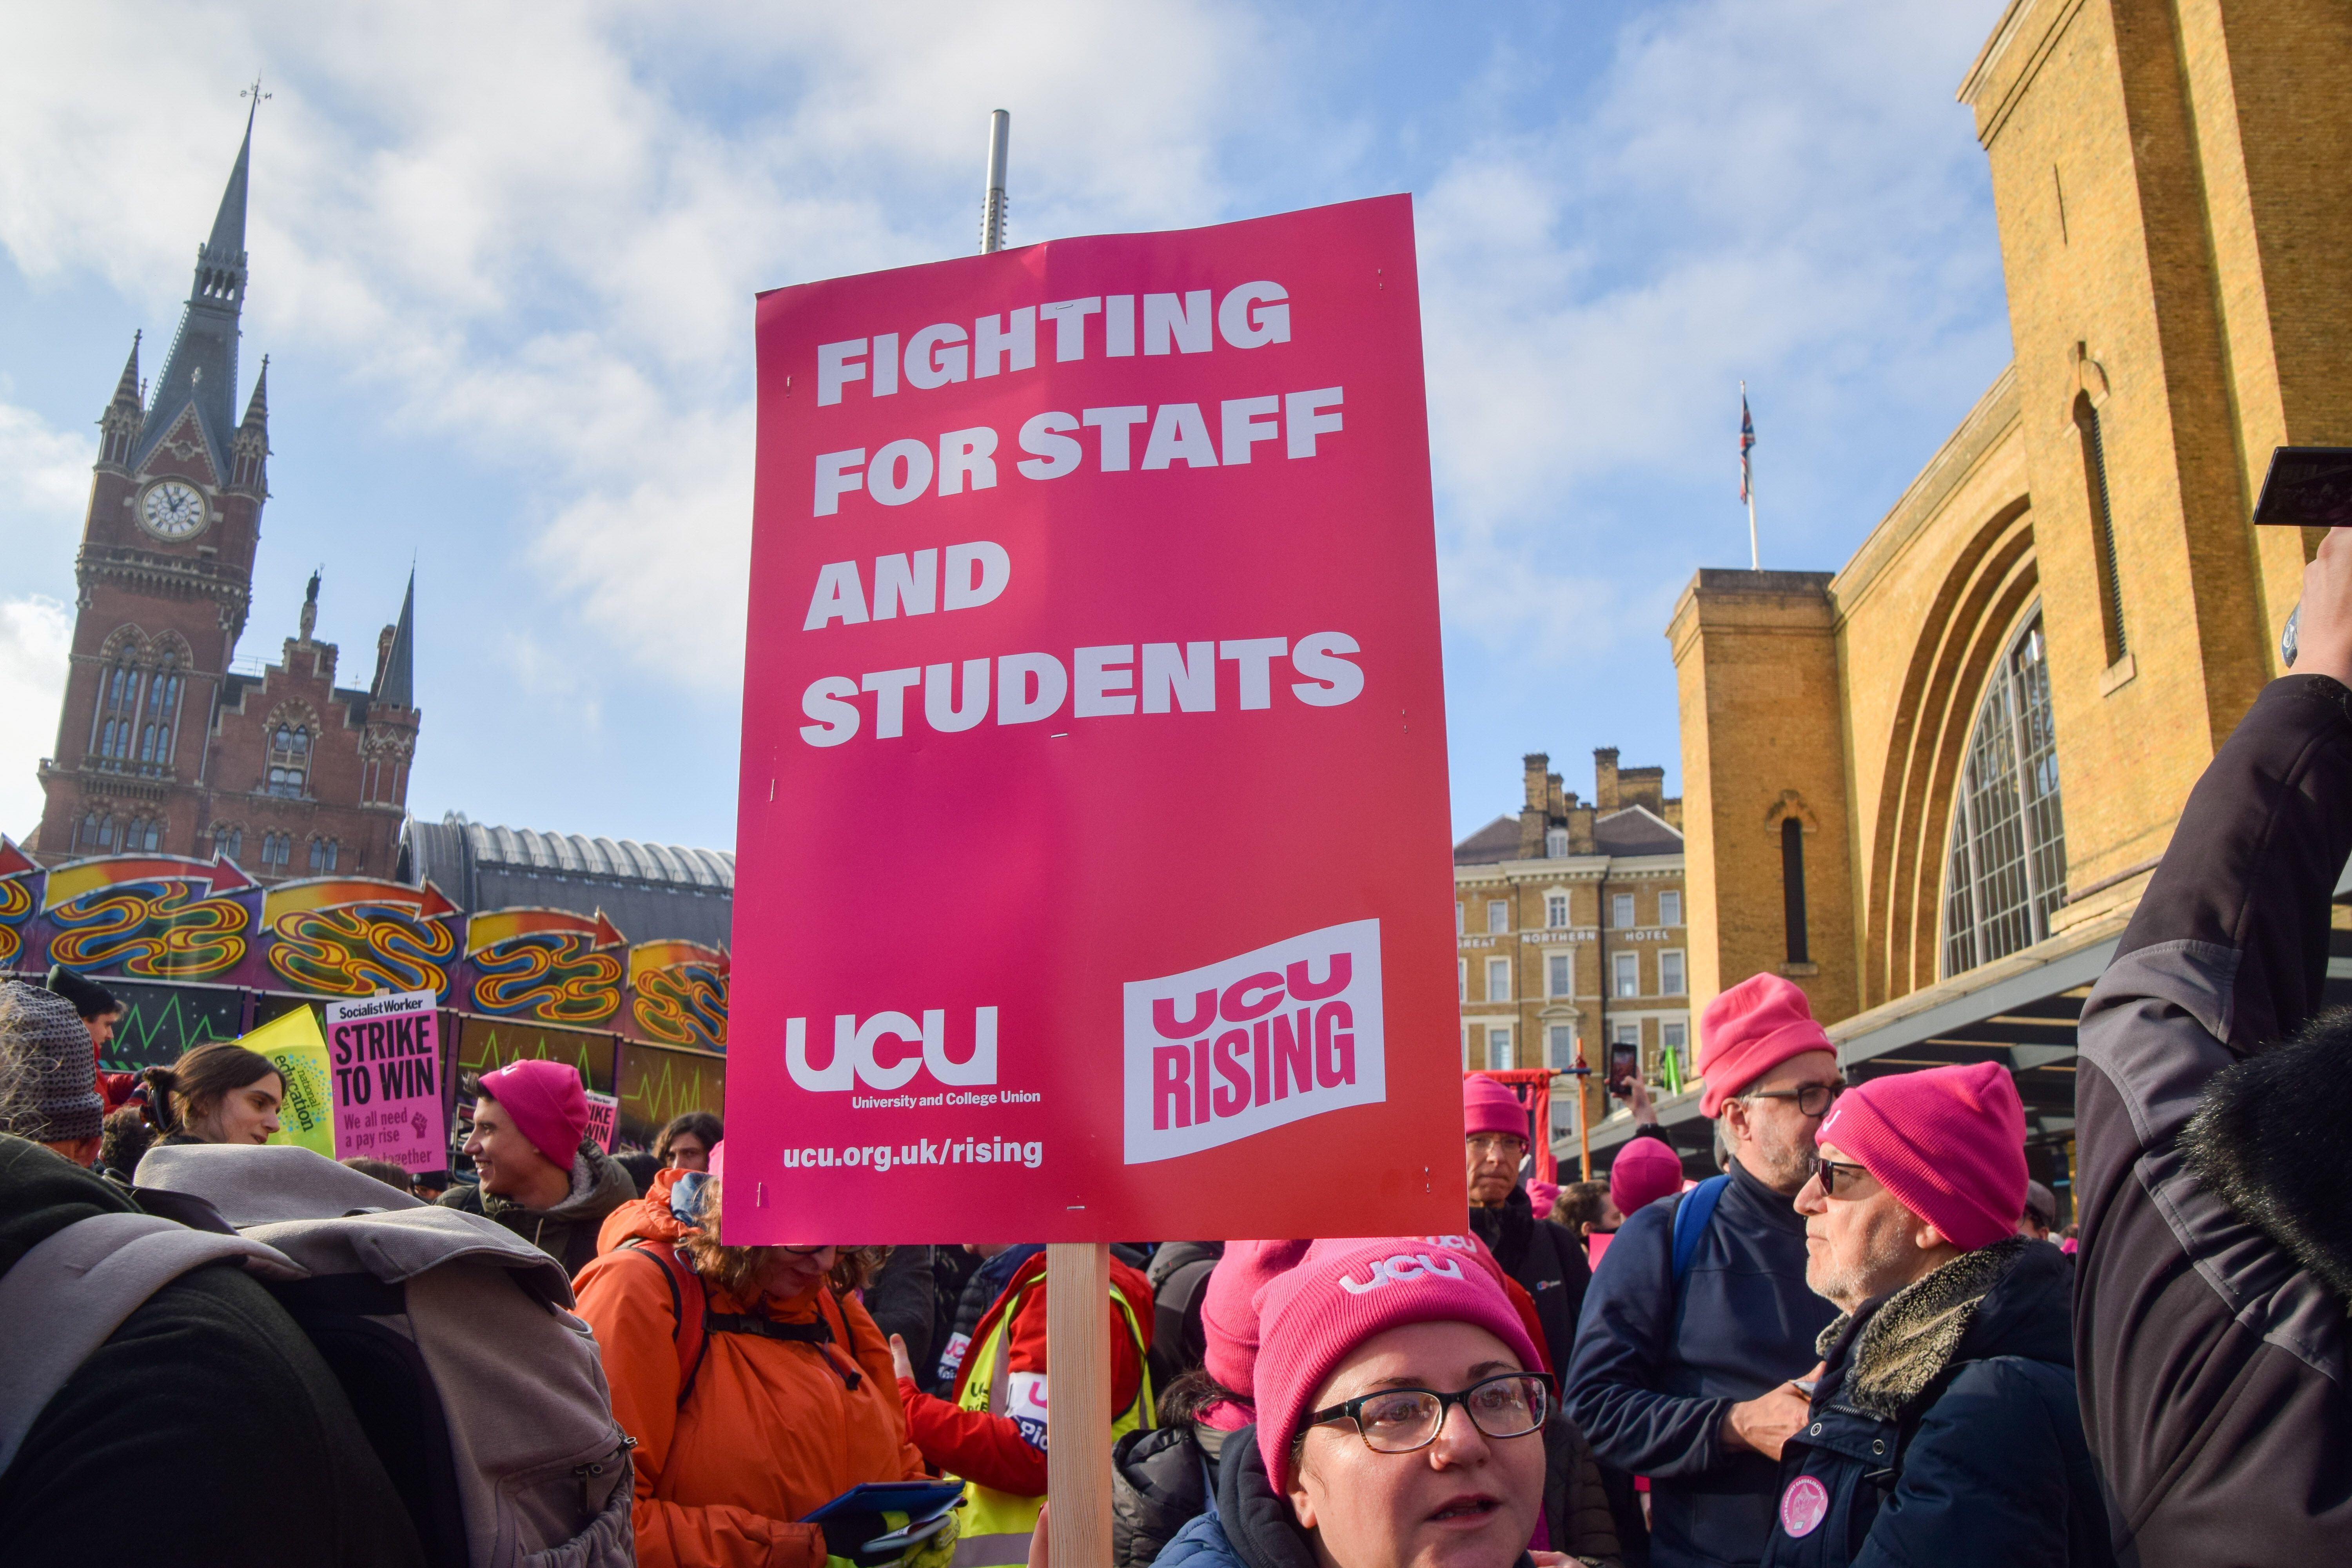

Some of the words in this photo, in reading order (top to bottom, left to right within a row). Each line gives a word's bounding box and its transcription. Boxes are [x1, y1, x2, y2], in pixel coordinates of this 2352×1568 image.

[818, 281, 1290, 407] FIGHTING
[814, 426, 998, 517] FOR
[1017, 386, 1343, 481] STAFF
[803, 541, 1011, 632] AND
[799, 632, 1365, 747] STUDENTS
[1521, 931, 1595, 944] NORTHERN
[1625, 930, 1670, 941] HOTEL
[339, 1002, 383, 1019] Socialist
[384, 998, 423, 1012] Worker
[1153, 952, 1352, 1039] UCU
[335, 1015, 432, 1065] STRIKE
[336, 1065, 371, 1106] TO
[379, 1057, 434, 1101] WIN
[1153, 1001, 1356, 1131] RISING
[298, 1070, 320, 1107] national
[853, 1095, 917, 1109] University
[919, 1093, 942, 1106] and
[946, 1092, 997, 1106] College
[1001, 1090, 1040, 1103] Union
[344, 1113, 360, 1130] We
[365, 1111, 377, 1127] all
[381, 1107, 407, 1125] need
[588, 1104, 612, 1124] IKE
[346, 1136, 351, 1147] a
[356, 1133, 375, 1150] pay
[379, 1128, 399, 1144] rise
[784, 1136, 1042, 1172] ucu.org.uk/rising
[1020, 1421, 1047, 1450] Pic
